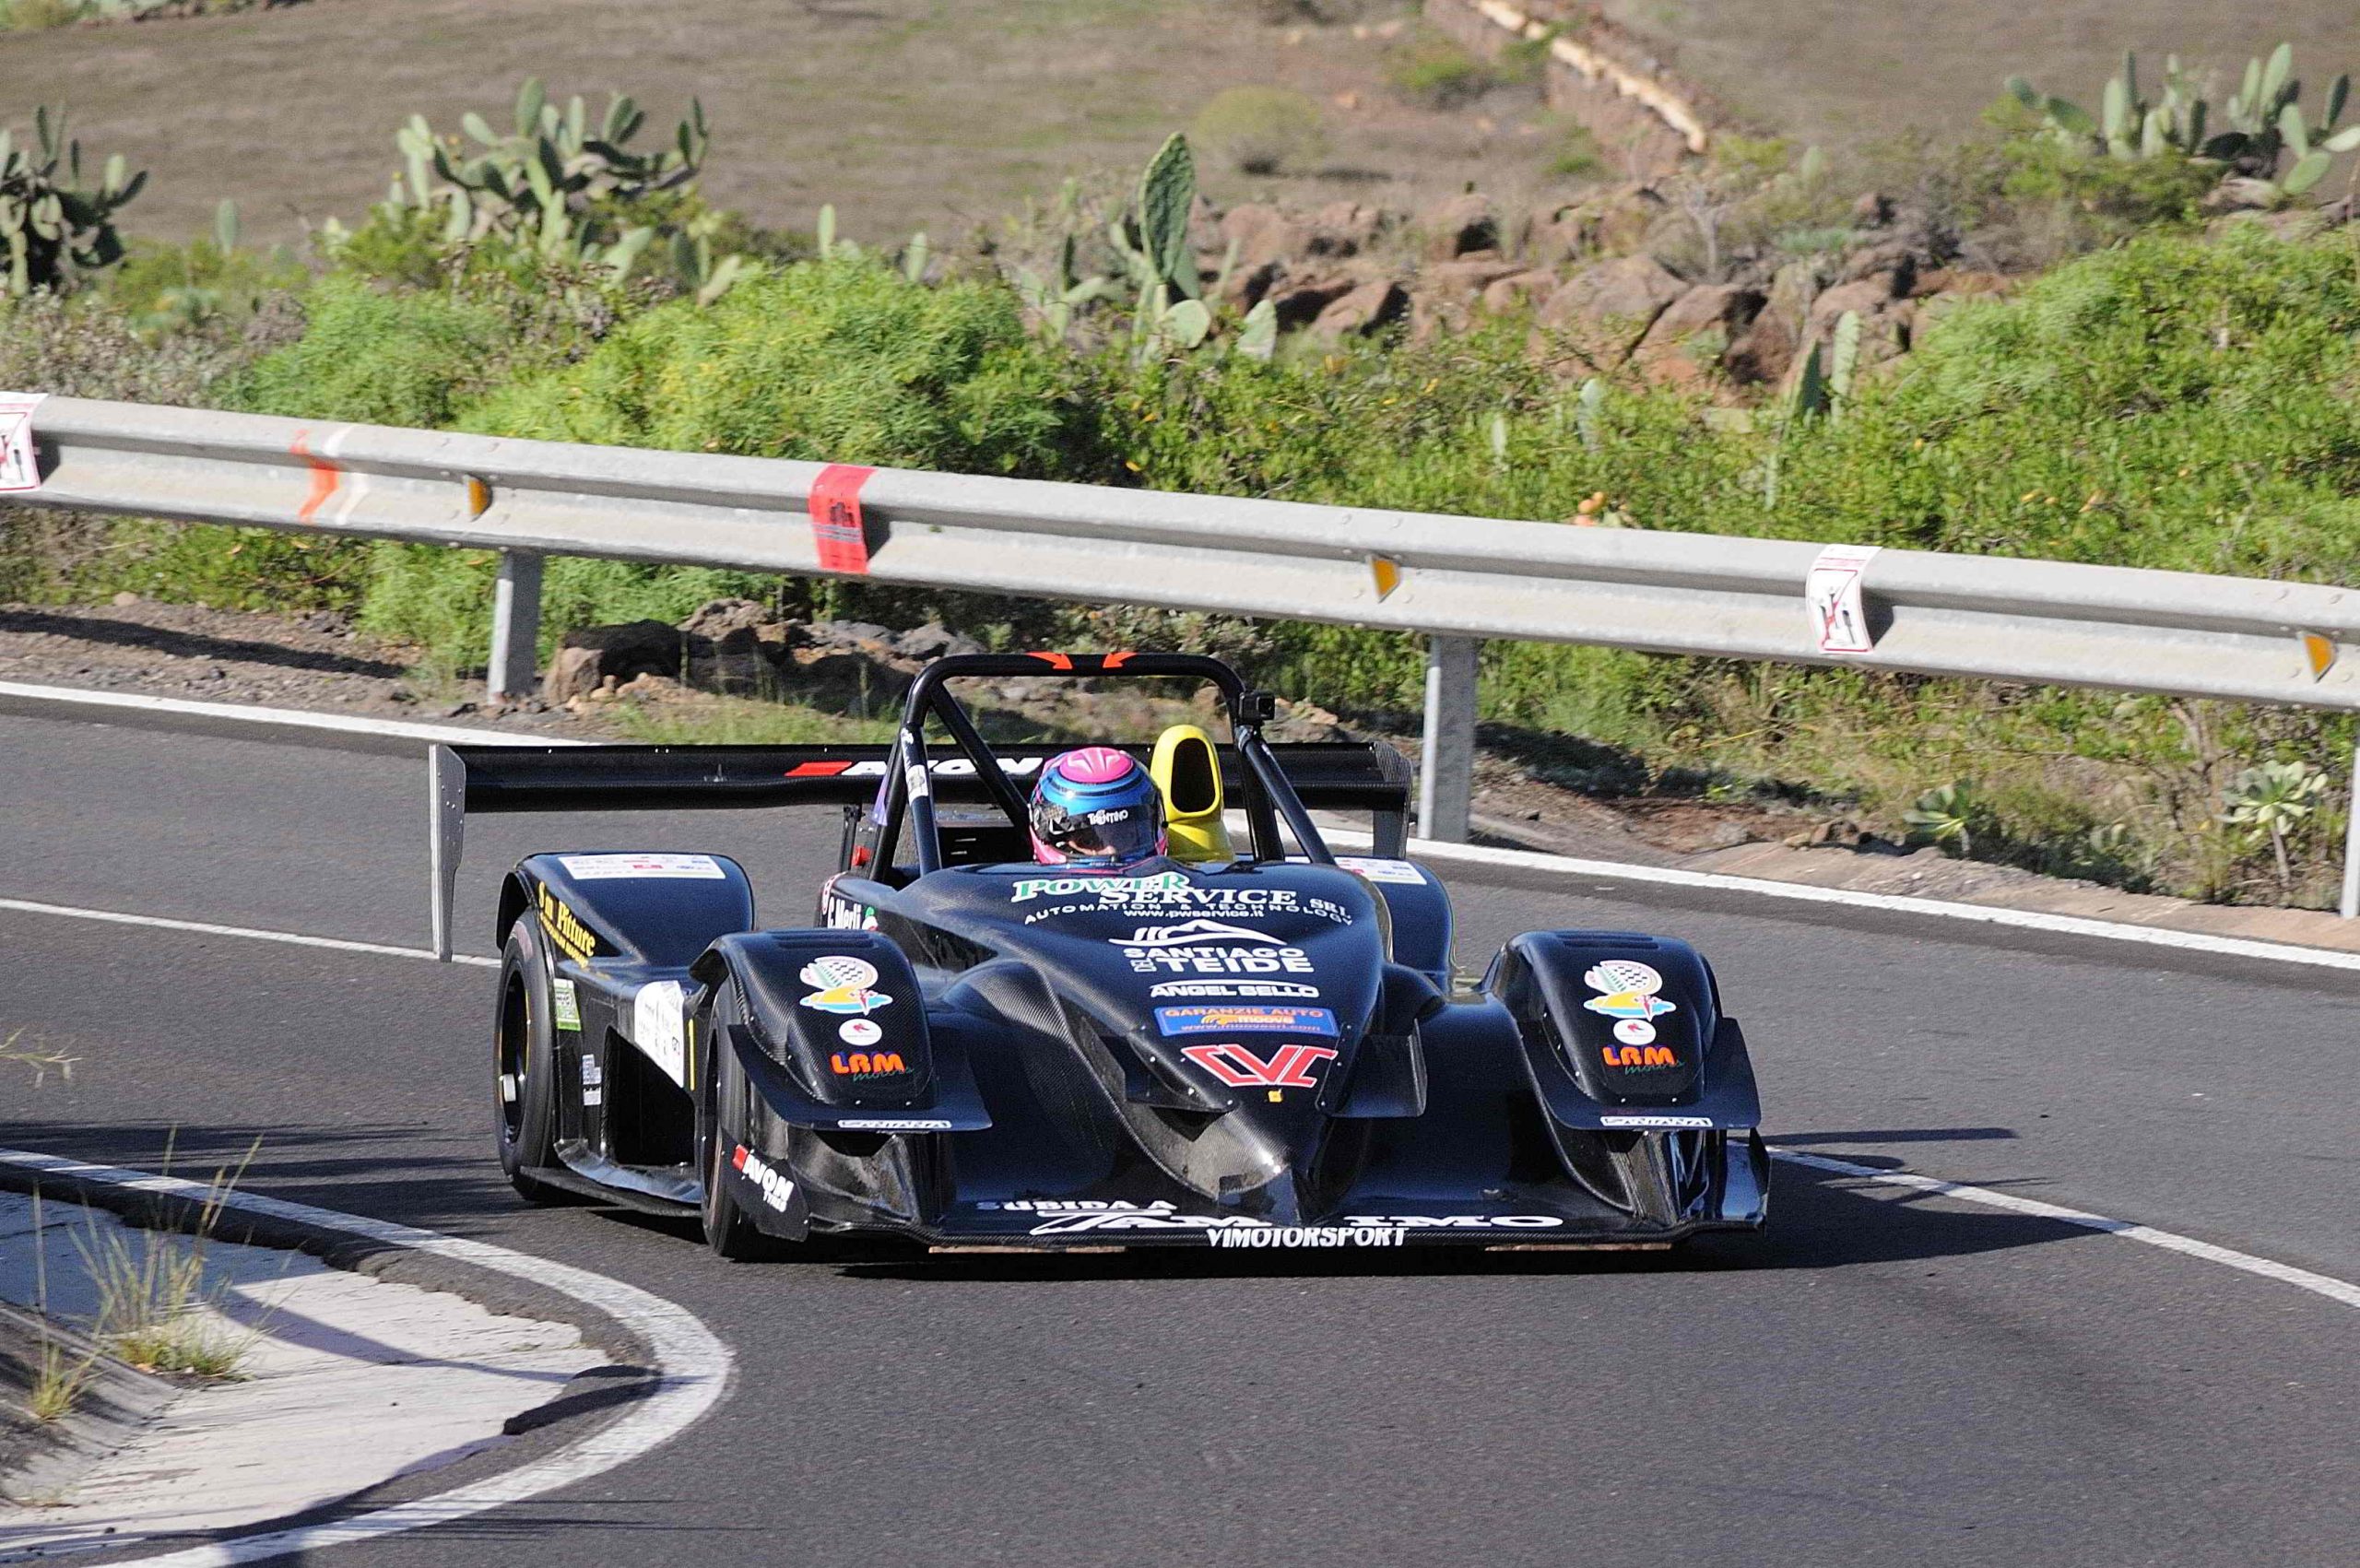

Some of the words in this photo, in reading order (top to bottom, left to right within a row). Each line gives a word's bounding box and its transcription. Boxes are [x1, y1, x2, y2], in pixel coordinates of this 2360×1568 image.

[1010, 871, 1195, 902] POWER
[1099, 889, 1297, 905] SERVICE
[1024, 902, 1152, 925] AUTOMATION
[1206, 902, 1353, 926] TECHNOLOGY
[1124, 910, 1264, 919] www.pwservice.it
[1309, 898, 1351, 920] SRL
[1123, 948, 1304, 959] SANTIAGO
[1155, 957, 1315, 973] TEIDE
[1150, 985, 1237, 997] ANGEL
[1238, 985, 1319, 997] BELLO
[1164, 1008, 1257, 1018] GARANZIE
[1269, 1008, 1324, 1018] AUTO
[832, 1051, 906, 1075] LRM
[1602, 1045, 1675, 1066] LRM
[742, 1154, 795, 1202] AVON
[977, 1200, 1138, 1211] SUBIDA
[1207, 1227, 1409, 1248] VIMOTORSPORT
